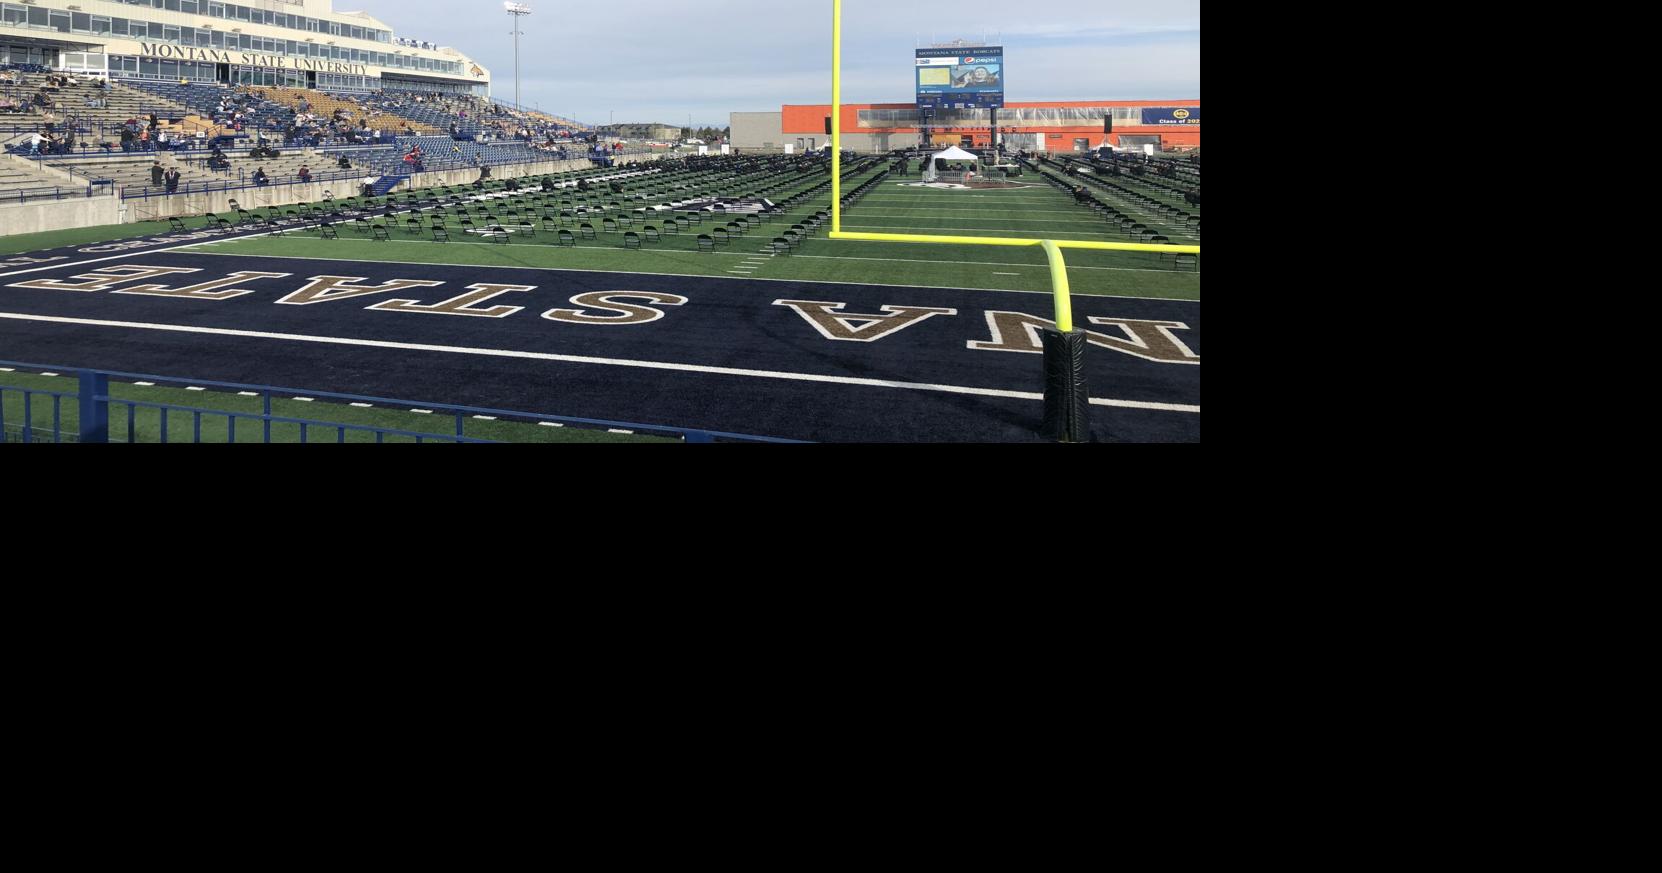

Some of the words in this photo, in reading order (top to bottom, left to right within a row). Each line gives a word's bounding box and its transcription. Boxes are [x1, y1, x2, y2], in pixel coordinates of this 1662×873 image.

[140, 42, 231, 63] MONTANA
[241, 52, 286, 67] STATE
[294, 58, 368, 75] UNIVERSITY
[5, 264, 689, 325] STATE
